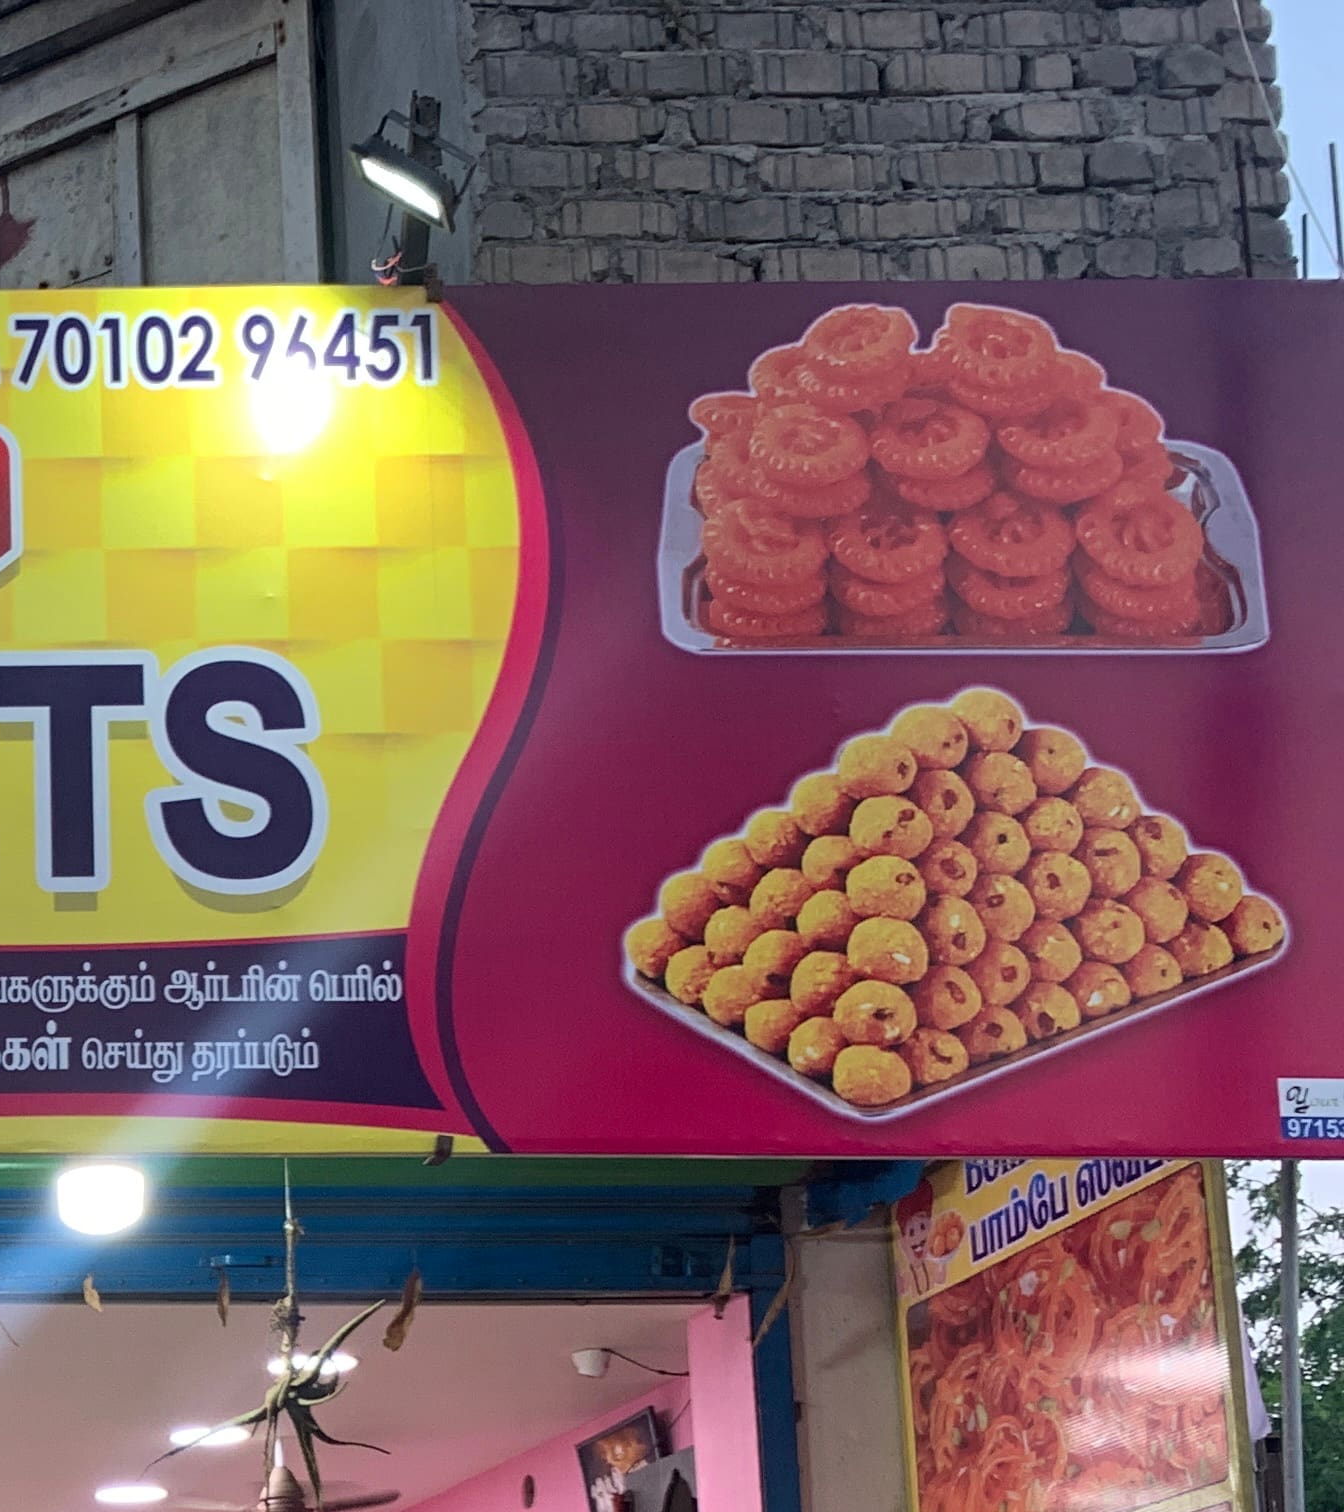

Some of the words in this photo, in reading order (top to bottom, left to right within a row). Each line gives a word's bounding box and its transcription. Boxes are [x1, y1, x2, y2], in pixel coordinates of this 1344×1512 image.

[13, 313, 216, 385] 70102
[243, 313, 434, 382] 96451
[81, 1027, 184, 1084] செய்து
